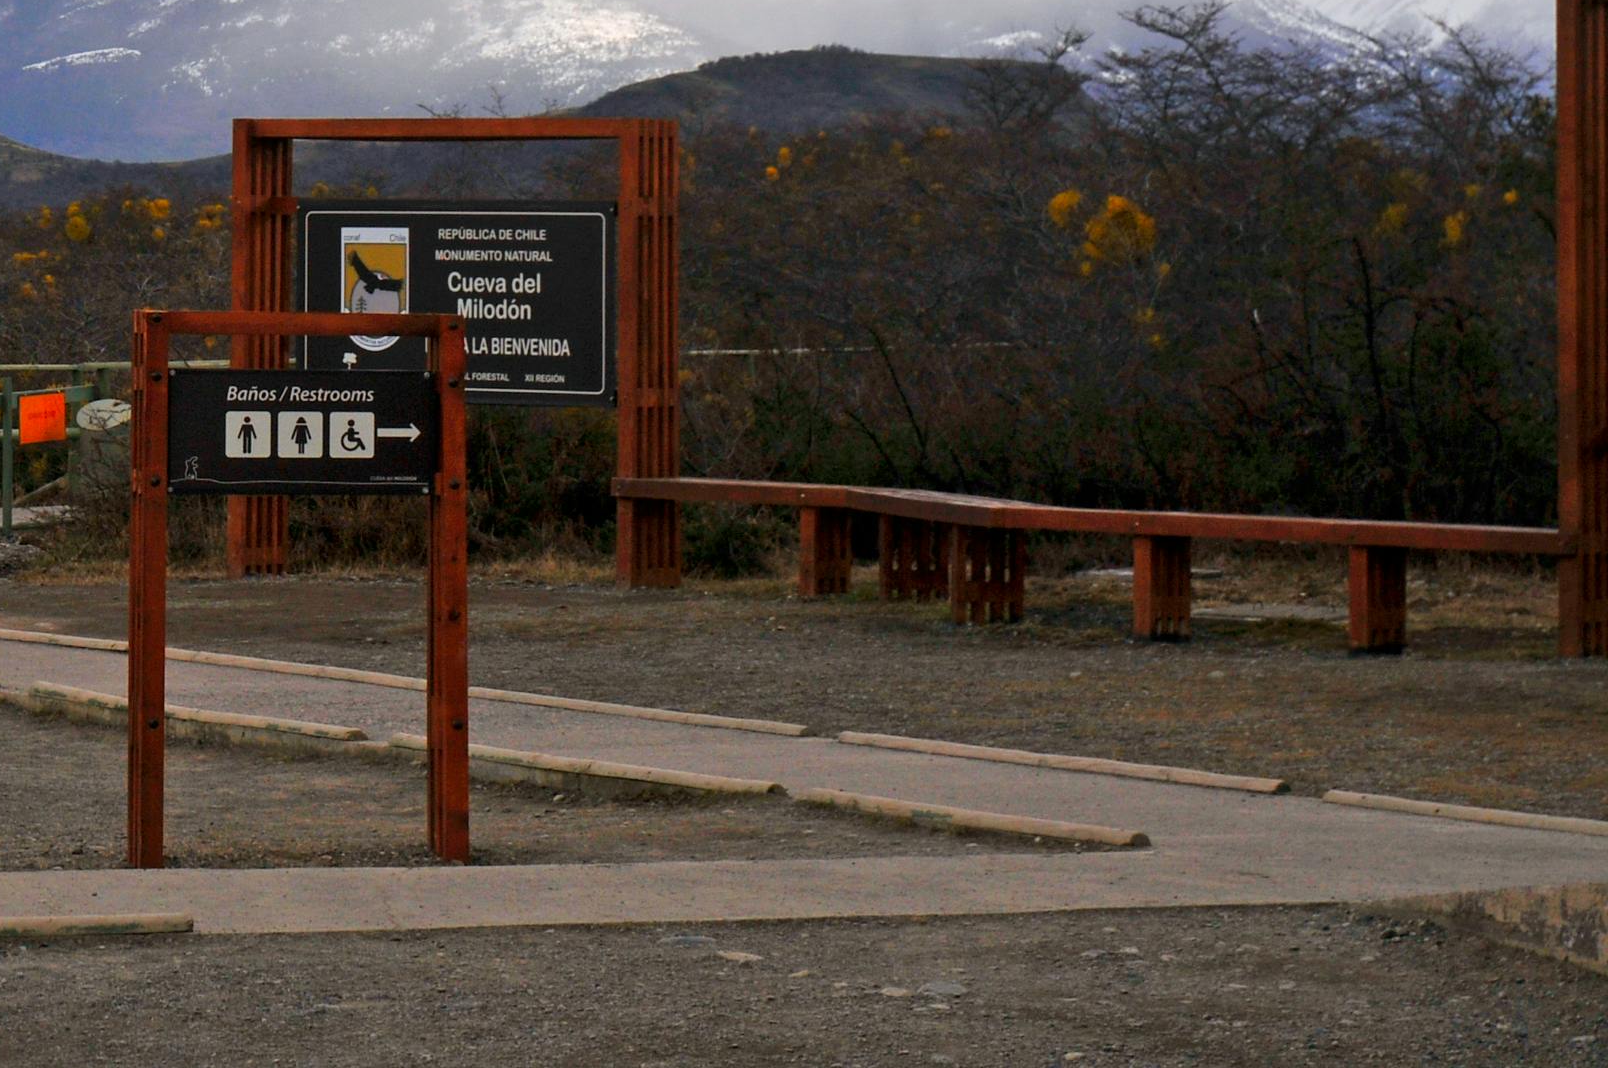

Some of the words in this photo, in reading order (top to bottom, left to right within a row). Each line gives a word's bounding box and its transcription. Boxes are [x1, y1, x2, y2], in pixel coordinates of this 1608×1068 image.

[438, 226, 496, 240] REPÚBLICA
[498, 229, 512, 240] DE
[515, 229, 547, 241] CHILE
[435, 249, 502, 261] MONUMENTO
[504, 250, 553, 262] NATURAL
[447, 271, 507, 293] Cueva
[511, 272, 541, 294] del
[457, 298, 532, 320] Milodón
[472, 337, 489, 355] LA
[491, 337, 571, 357] BIENVENIDA
[472, 372, 511, 382] FORESTAL
[536, 372, 566, 384] REGIÓN
[227, 385, 277, 402] Baños
[289, 385, 375, 403] Restrooms
